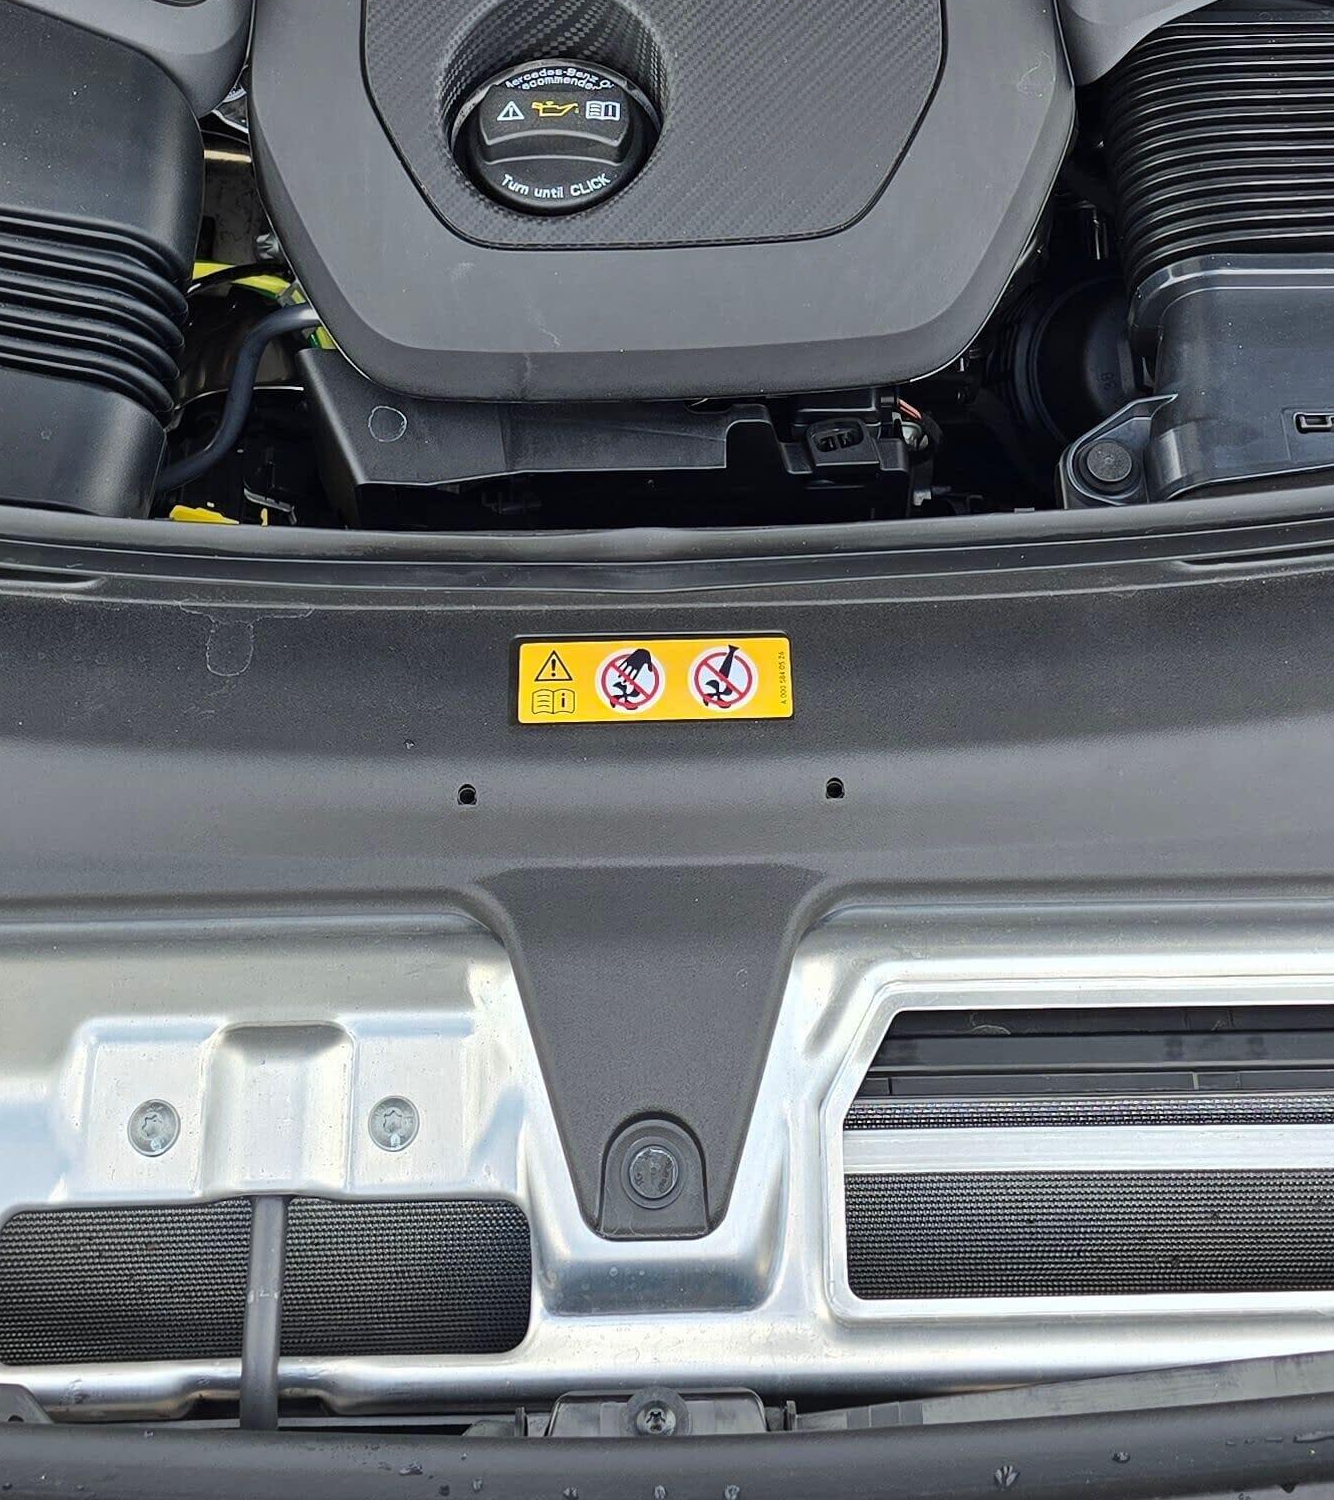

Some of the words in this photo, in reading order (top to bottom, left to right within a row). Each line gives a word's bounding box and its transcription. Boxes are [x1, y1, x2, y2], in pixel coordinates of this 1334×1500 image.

[501, 173, 530, 197] Turn
[533, 186, 565, 200] until
[569, 172, 612, 198] CLICK
